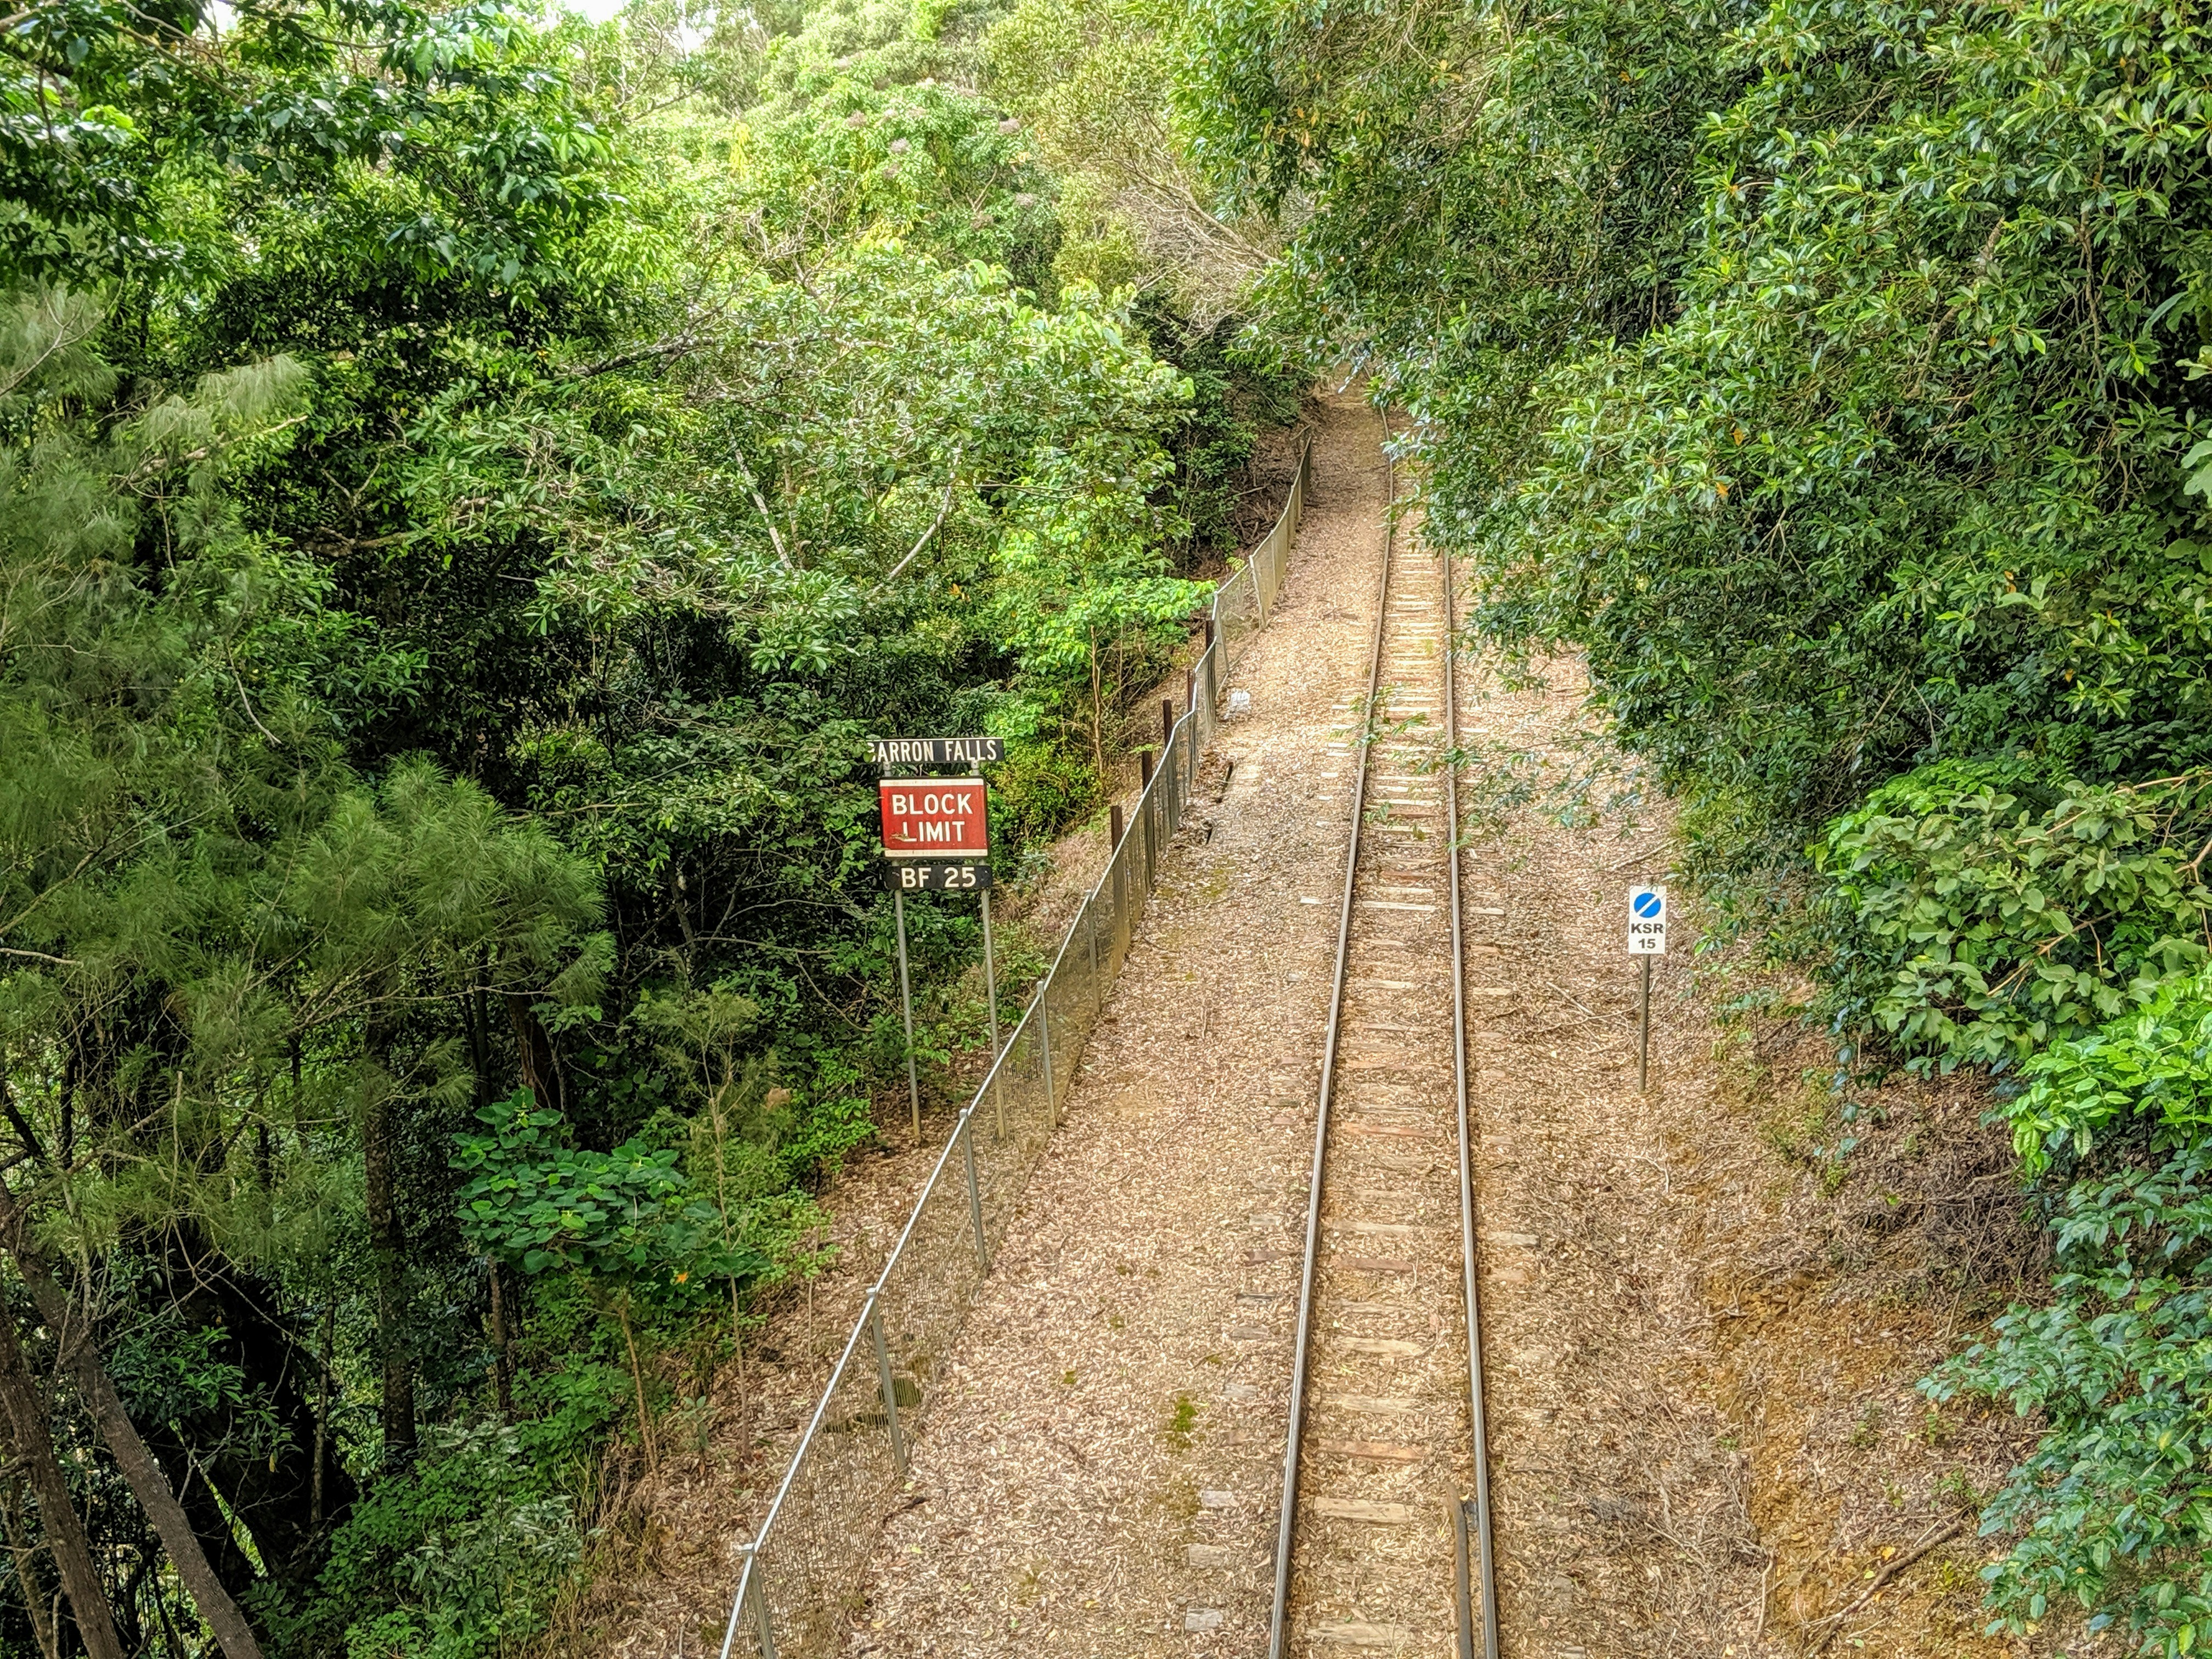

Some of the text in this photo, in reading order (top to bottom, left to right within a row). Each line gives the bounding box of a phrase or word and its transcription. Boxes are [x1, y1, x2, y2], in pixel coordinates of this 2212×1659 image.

[945, 740, 997, 761] FALLS
[892, 793, 973, 815] BLOCK
[902, 821, 965, 842] LIMIT
[901, 867, 977, 888] BF 25
[1630, 923, 1663, 934] KSR
[1638, 938, 1656, 949] 15
